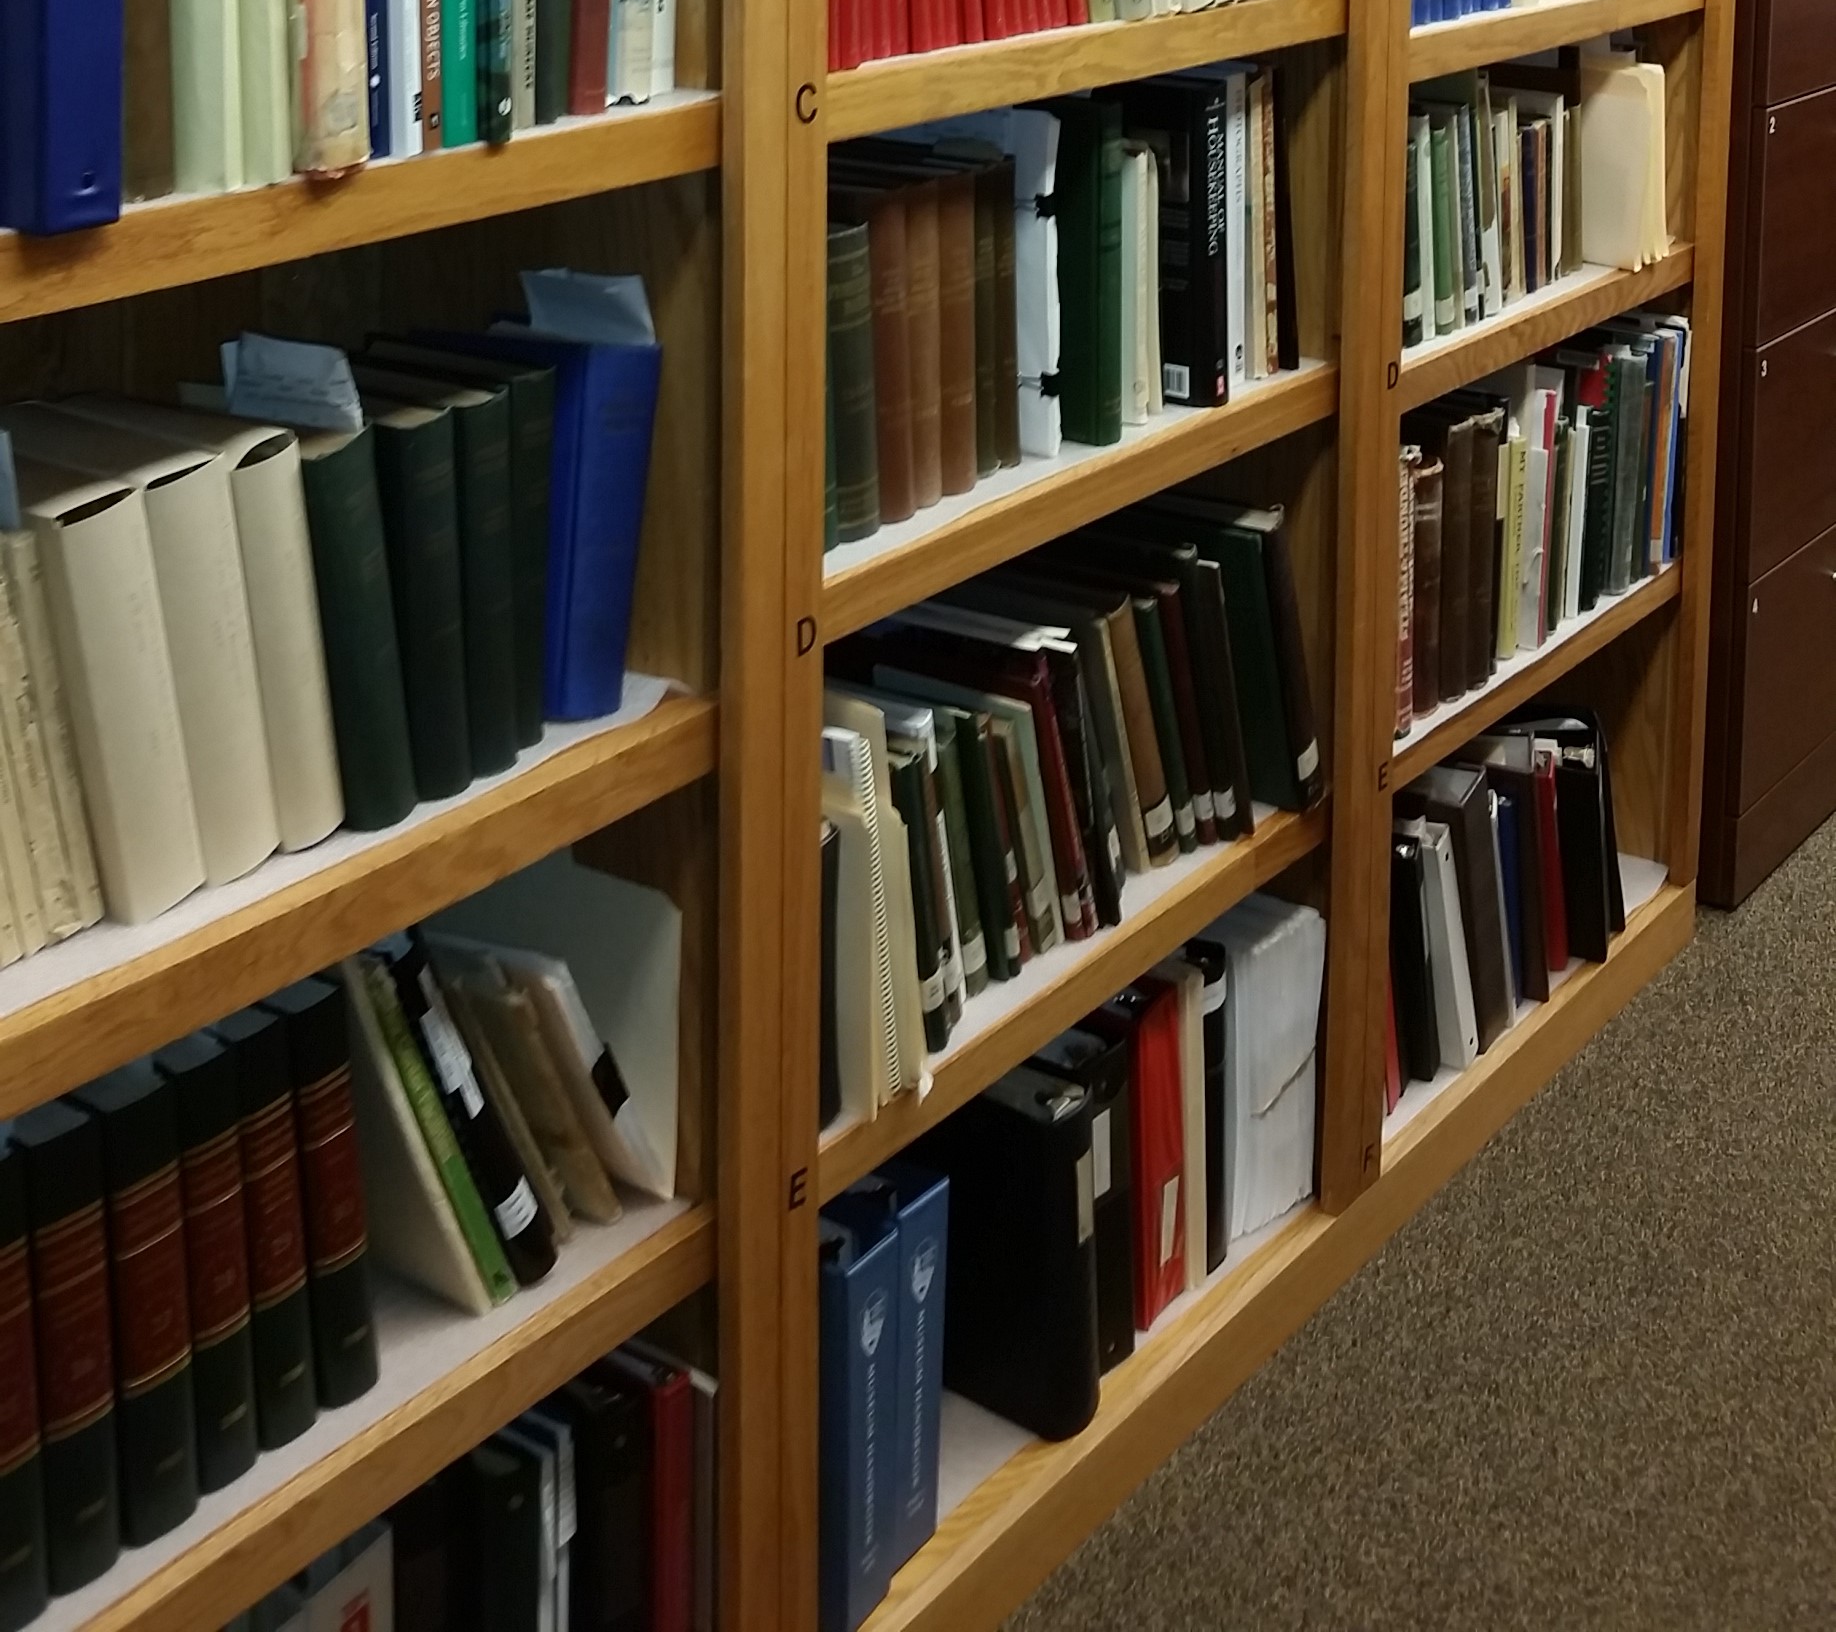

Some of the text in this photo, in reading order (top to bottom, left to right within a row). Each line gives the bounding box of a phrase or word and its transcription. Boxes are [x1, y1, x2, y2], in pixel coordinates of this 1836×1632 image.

[424, 11, 441, 81] OBJECTS
[796, 82, 817, 124] C
[1768, 115, 1776, 134] 2
[1207, 116, 1220, 257] HOUSEKEEPING
[1216, 133, 1226, 234] MANUAL OF
[1387, 362, 1399, 390] D
[1760, 359, 1768, 377] 3
[1518, 450, 1527, 473] MY
[1514, 483, 1525, 553] PARTNER
[1751, 597, 1759, 614] 4
[797, 617, 817, 657] D
[1378, 761, 1389, 791] E
[1363, 1142, 1375, 1173] F
[789, 1167, 809, 1210] E
